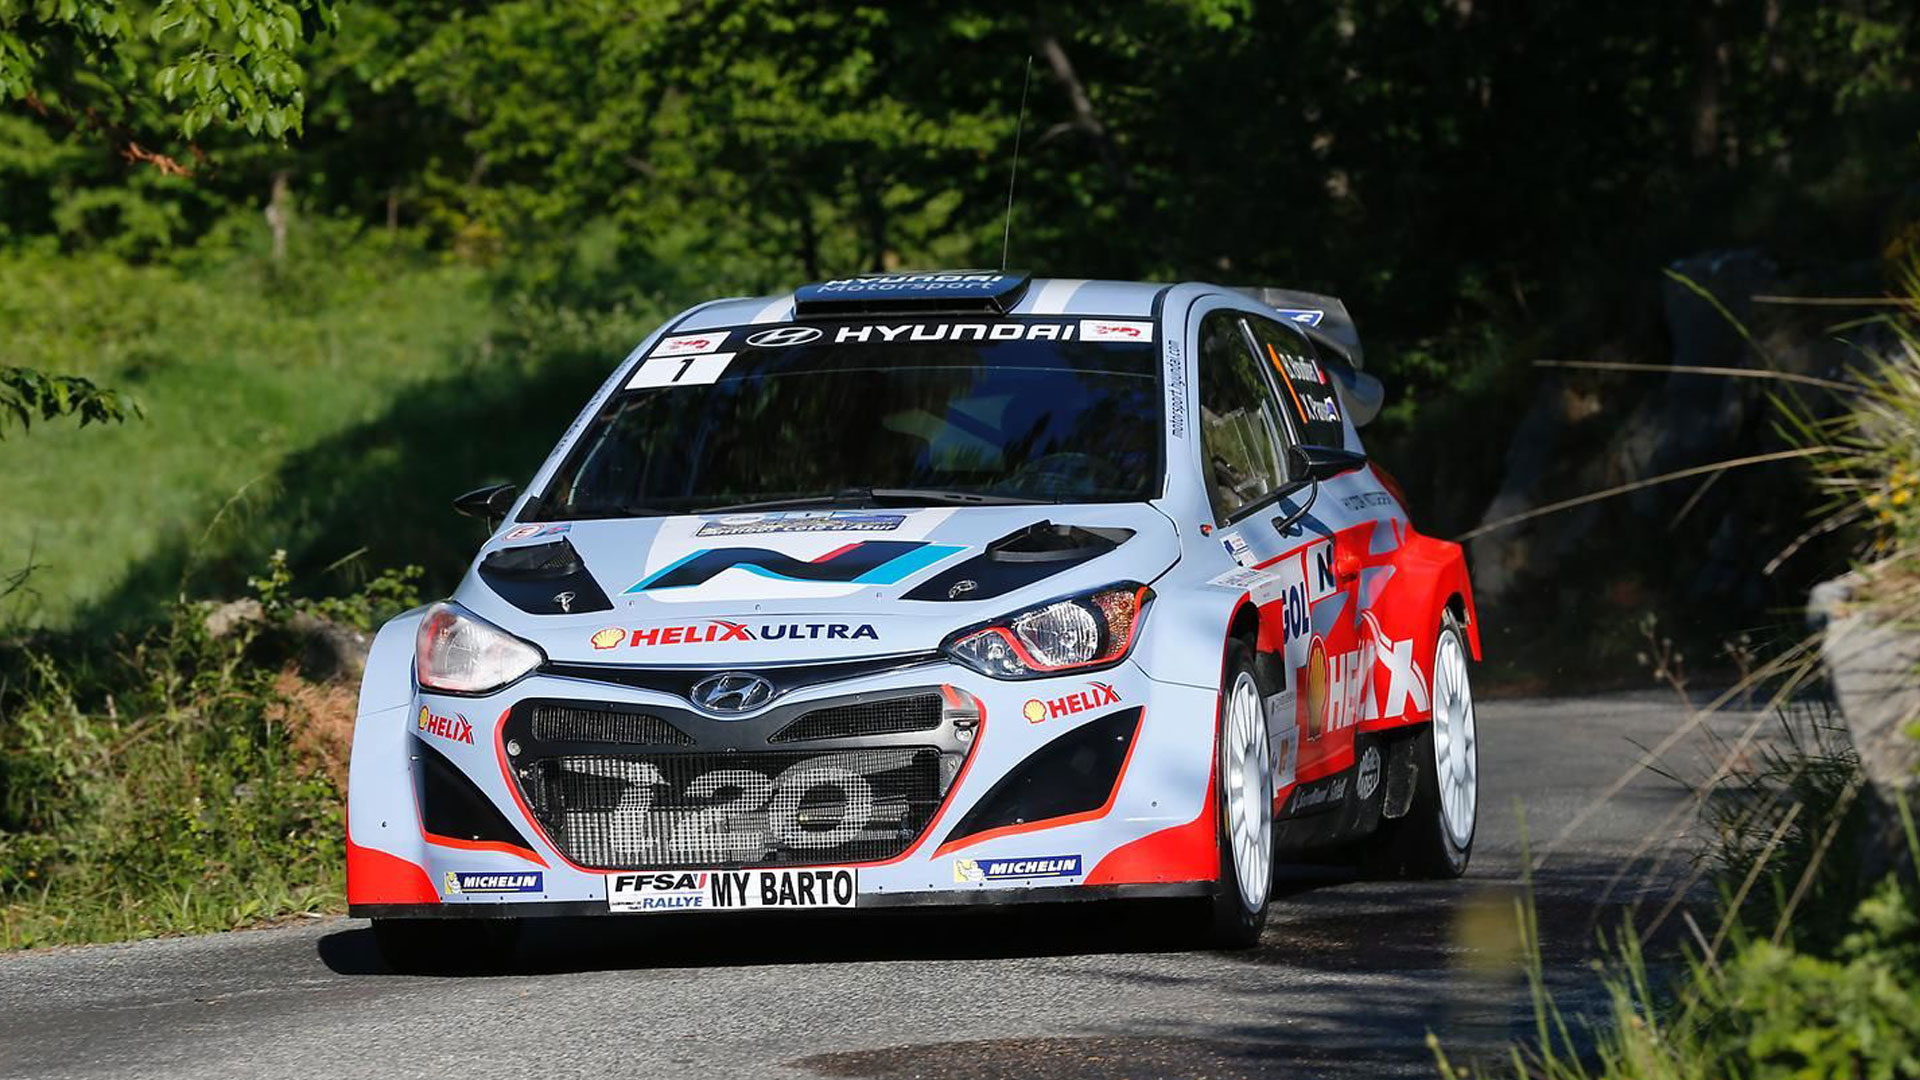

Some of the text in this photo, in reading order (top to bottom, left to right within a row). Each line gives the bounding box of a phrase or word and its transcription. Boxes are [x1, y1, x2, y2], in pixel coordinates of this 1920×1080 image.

[817, 281, 994, 293] Motorsport
[834, 324, 1076, 343] HYUNDAI
[671, 358, 696, 383] 1
[629, 619, 879, 647] HELIX ULTRA
[1047, 681, 1121, 719] HELIX
[427, 711, 475, 745] HELIX
[989, 859, 1077, 875] MICHELIN
[463, 875, 537, 888] MICHELIN
[615, 873, 698, 893] FFSA
[711, 869, 851, 908] MY BARTO
[643, 897, 703, 909] RALLYE
